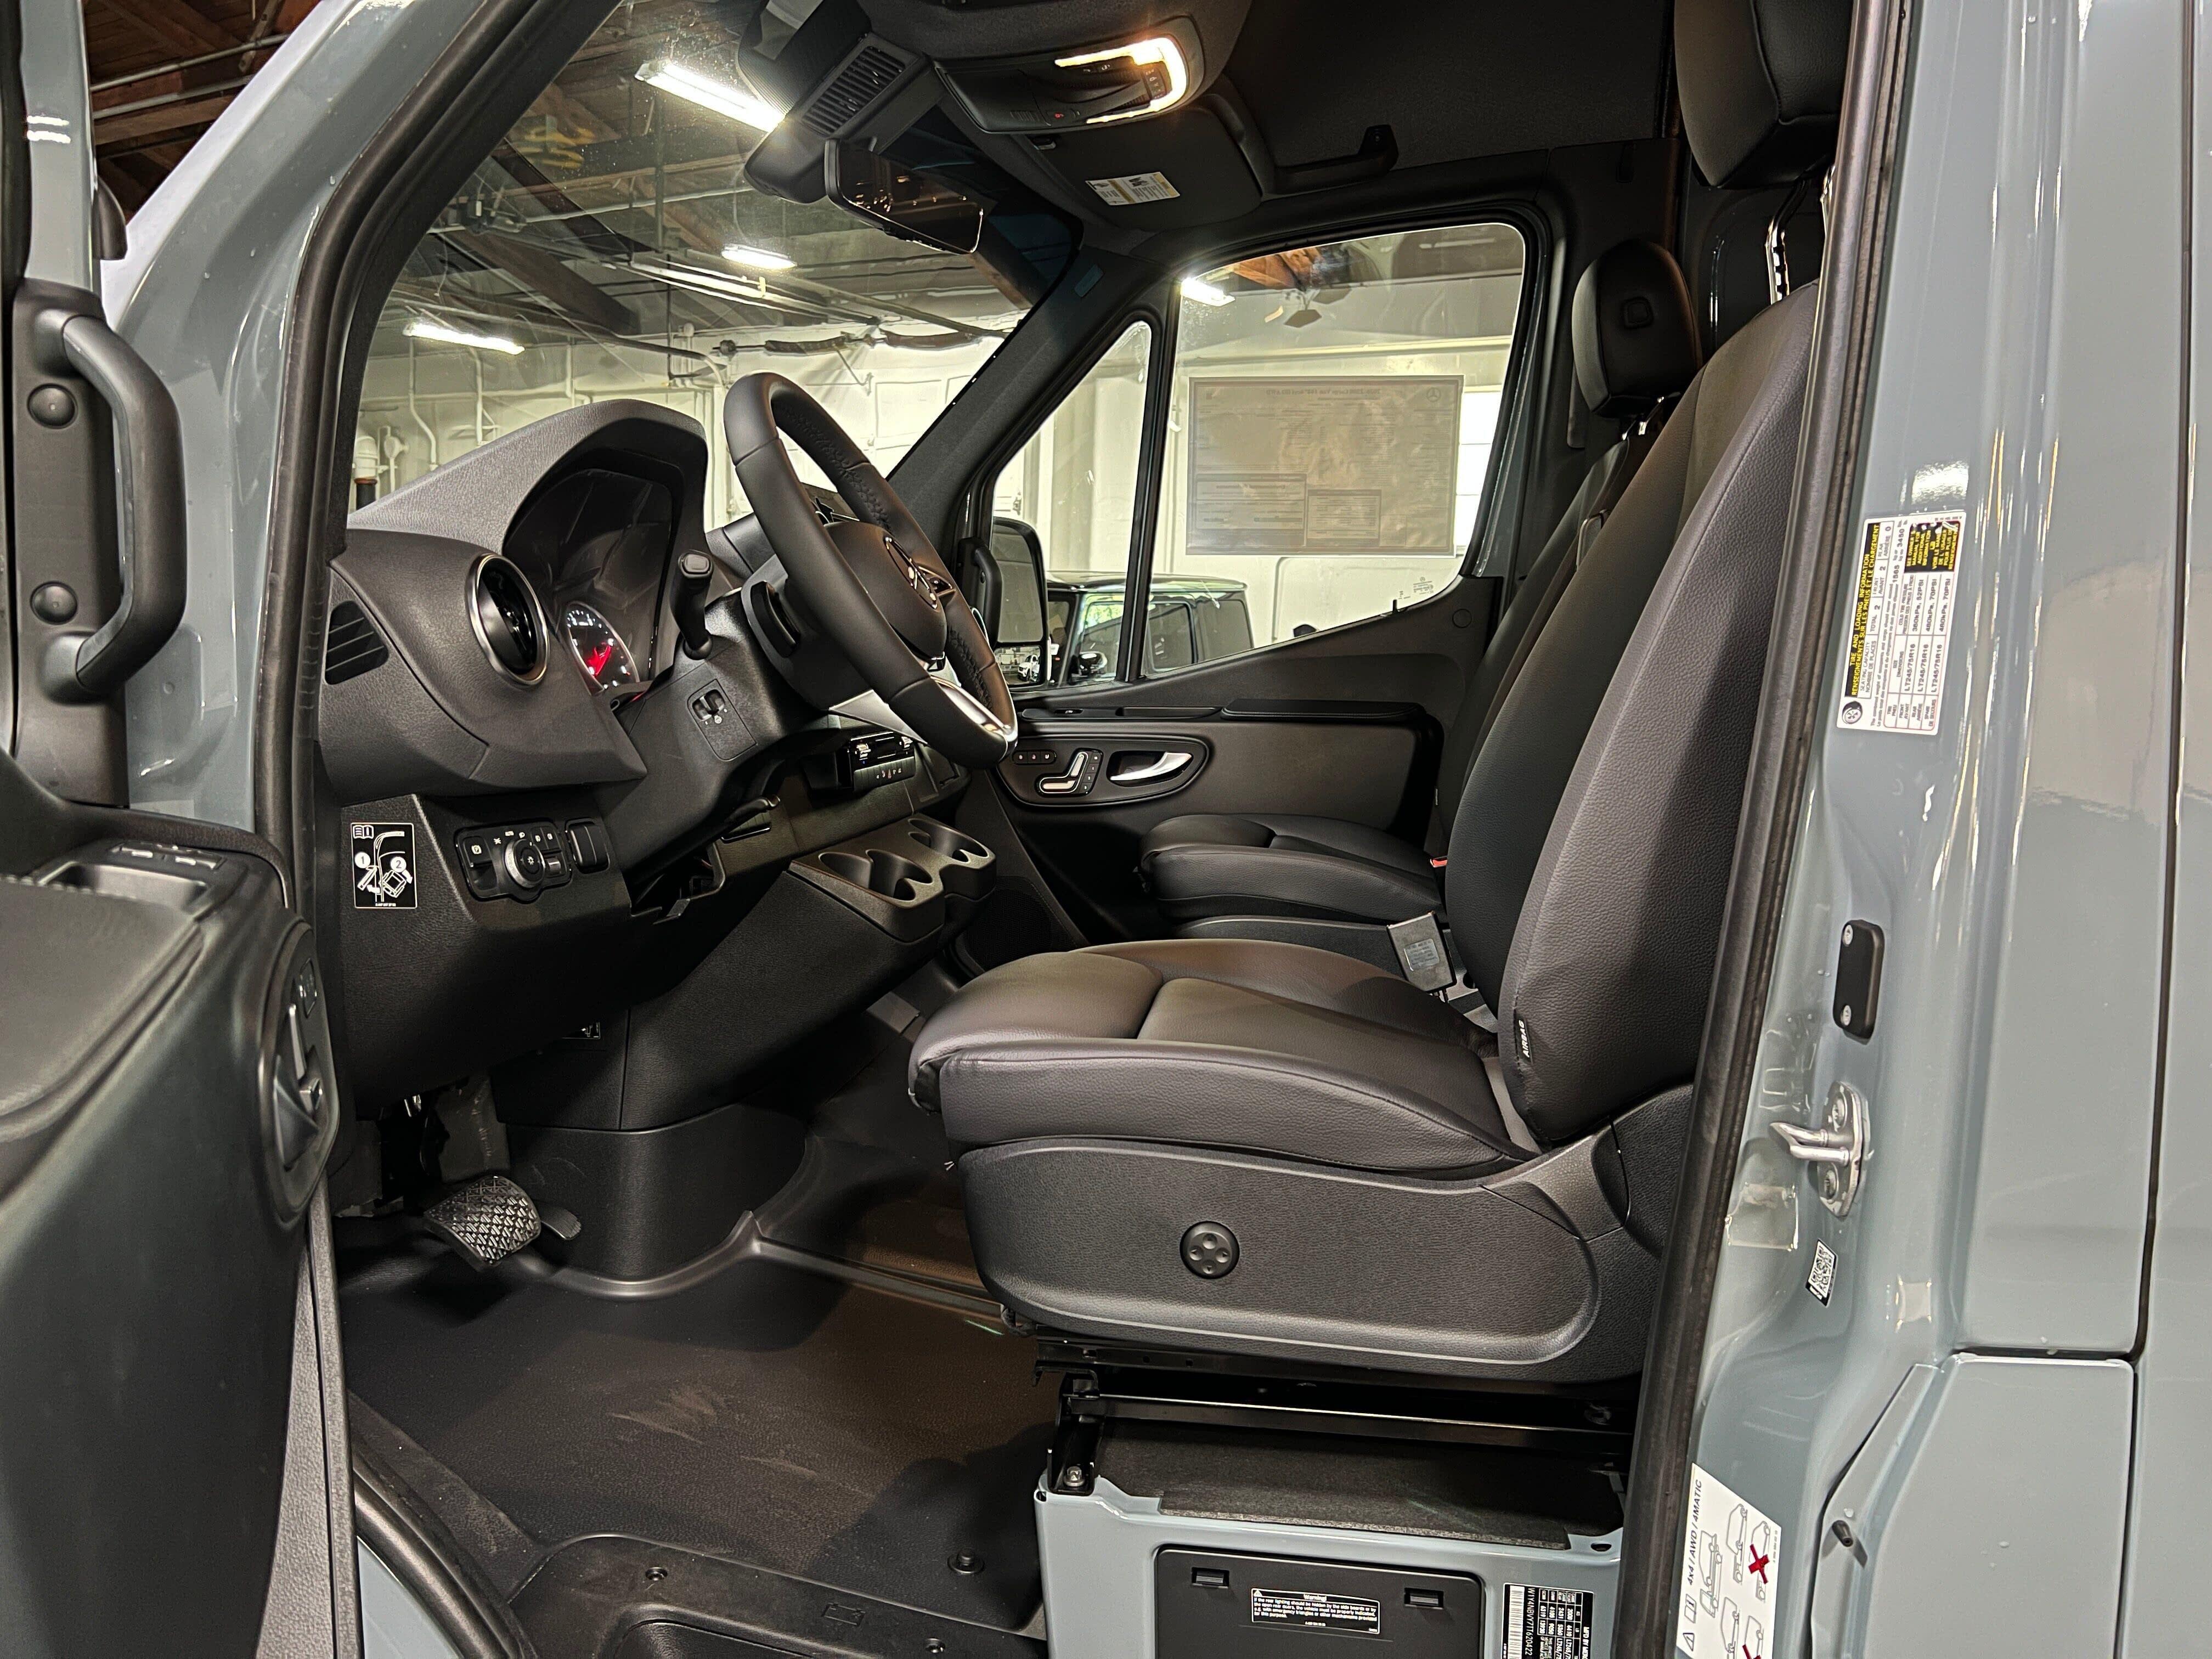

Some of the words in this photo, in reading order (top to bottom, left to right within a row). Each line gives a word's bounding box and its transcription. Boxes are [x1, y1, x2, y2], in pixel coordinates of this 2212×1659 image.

[1852, 640, 1864, 695] RENSEIGNEMENTS
[1869, 524, 1880, 567] CHARGEMENT
[1854, 602, 1864, 630] LOADING
[1859, 554, 1870, 597] INFORMATION
[1904, 644, 1916, 691] LT245/75R16
[1917, 644, 1929, 692] LT245/75R16
[1931, 645, 1943, 692] LT245/75R16
[396, 860, 402, 869] 2
[1519, 1020, 1530, 1058] AIRBAG
[1692, 1479, 1702, 1522] 4MATIC
[1525, 1588, 1536, 1656] W1Y4NBVY7TT620422
